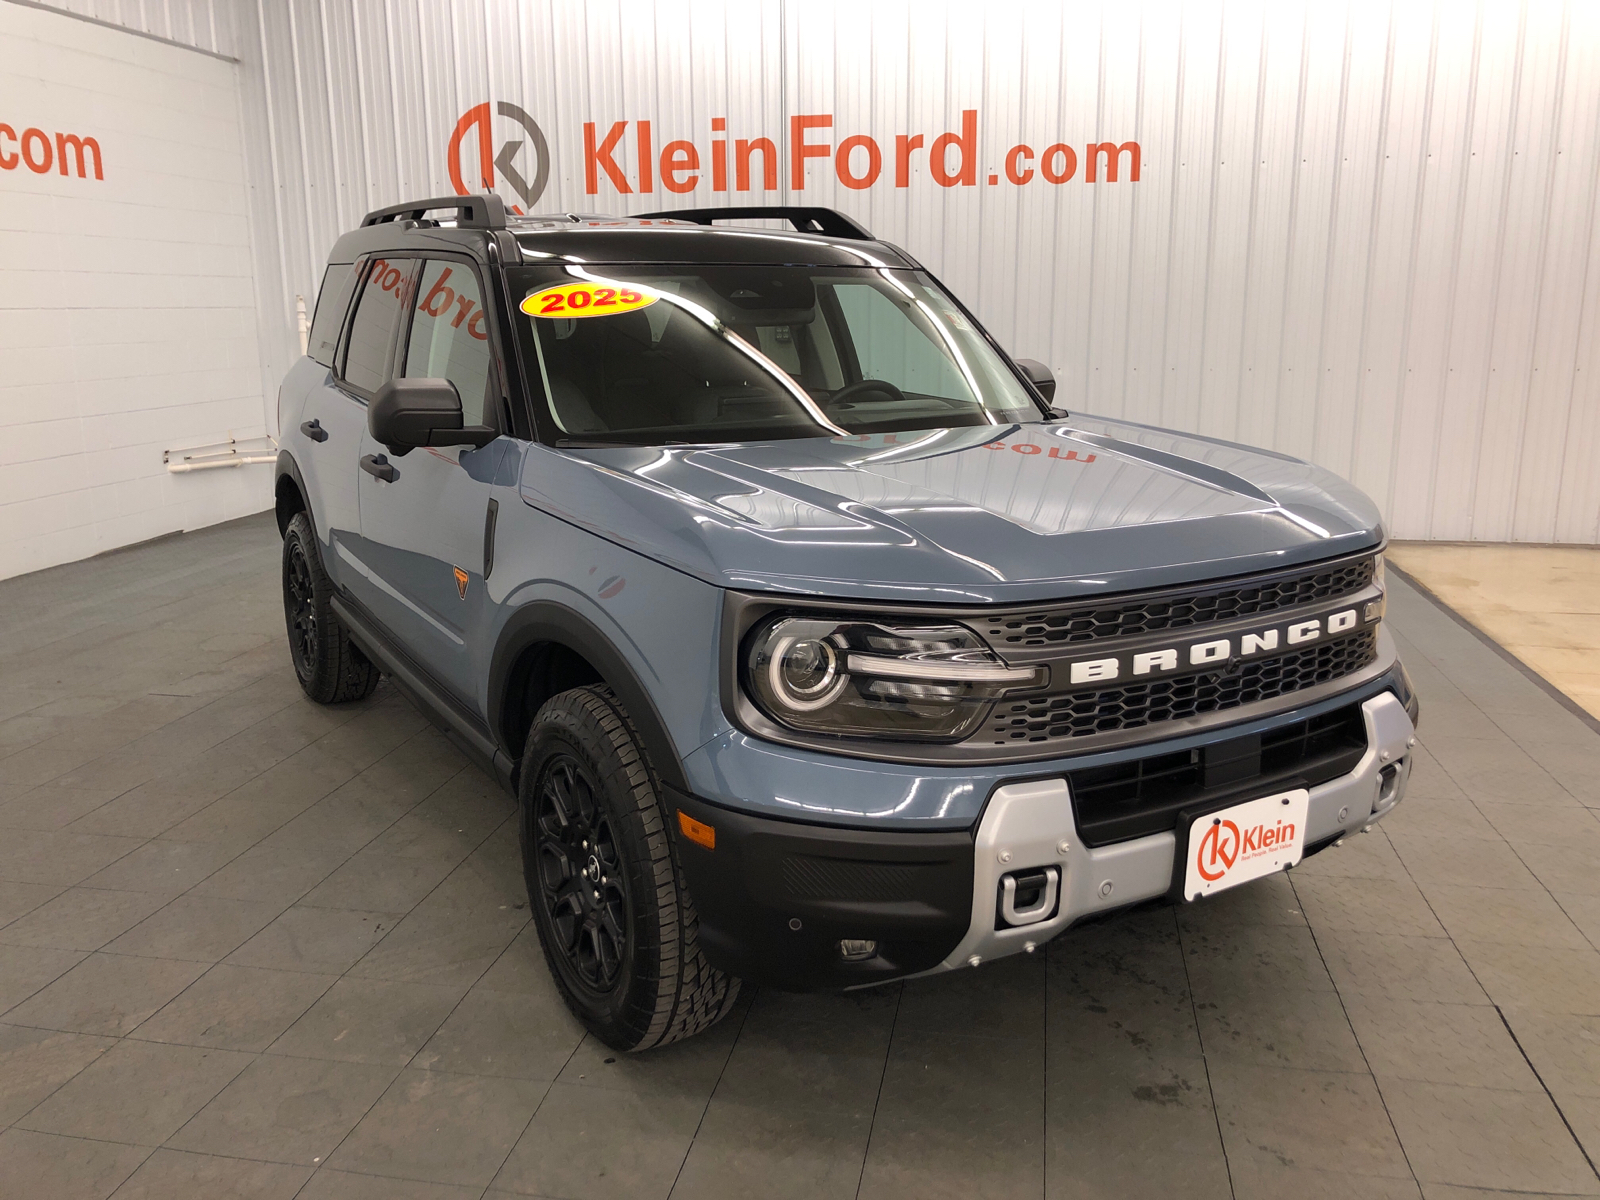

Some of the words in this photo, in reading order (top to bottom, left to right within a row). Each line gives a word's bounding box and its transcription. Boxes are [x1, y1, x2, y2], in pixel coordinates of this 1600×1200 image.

[583, 109, 1142, 195] KleinFord.com
[540, 288, 643, 313] 2025
[1070, 608, 1357, 685] BRONCO
[1242, 819, 1295, 854] Klein
